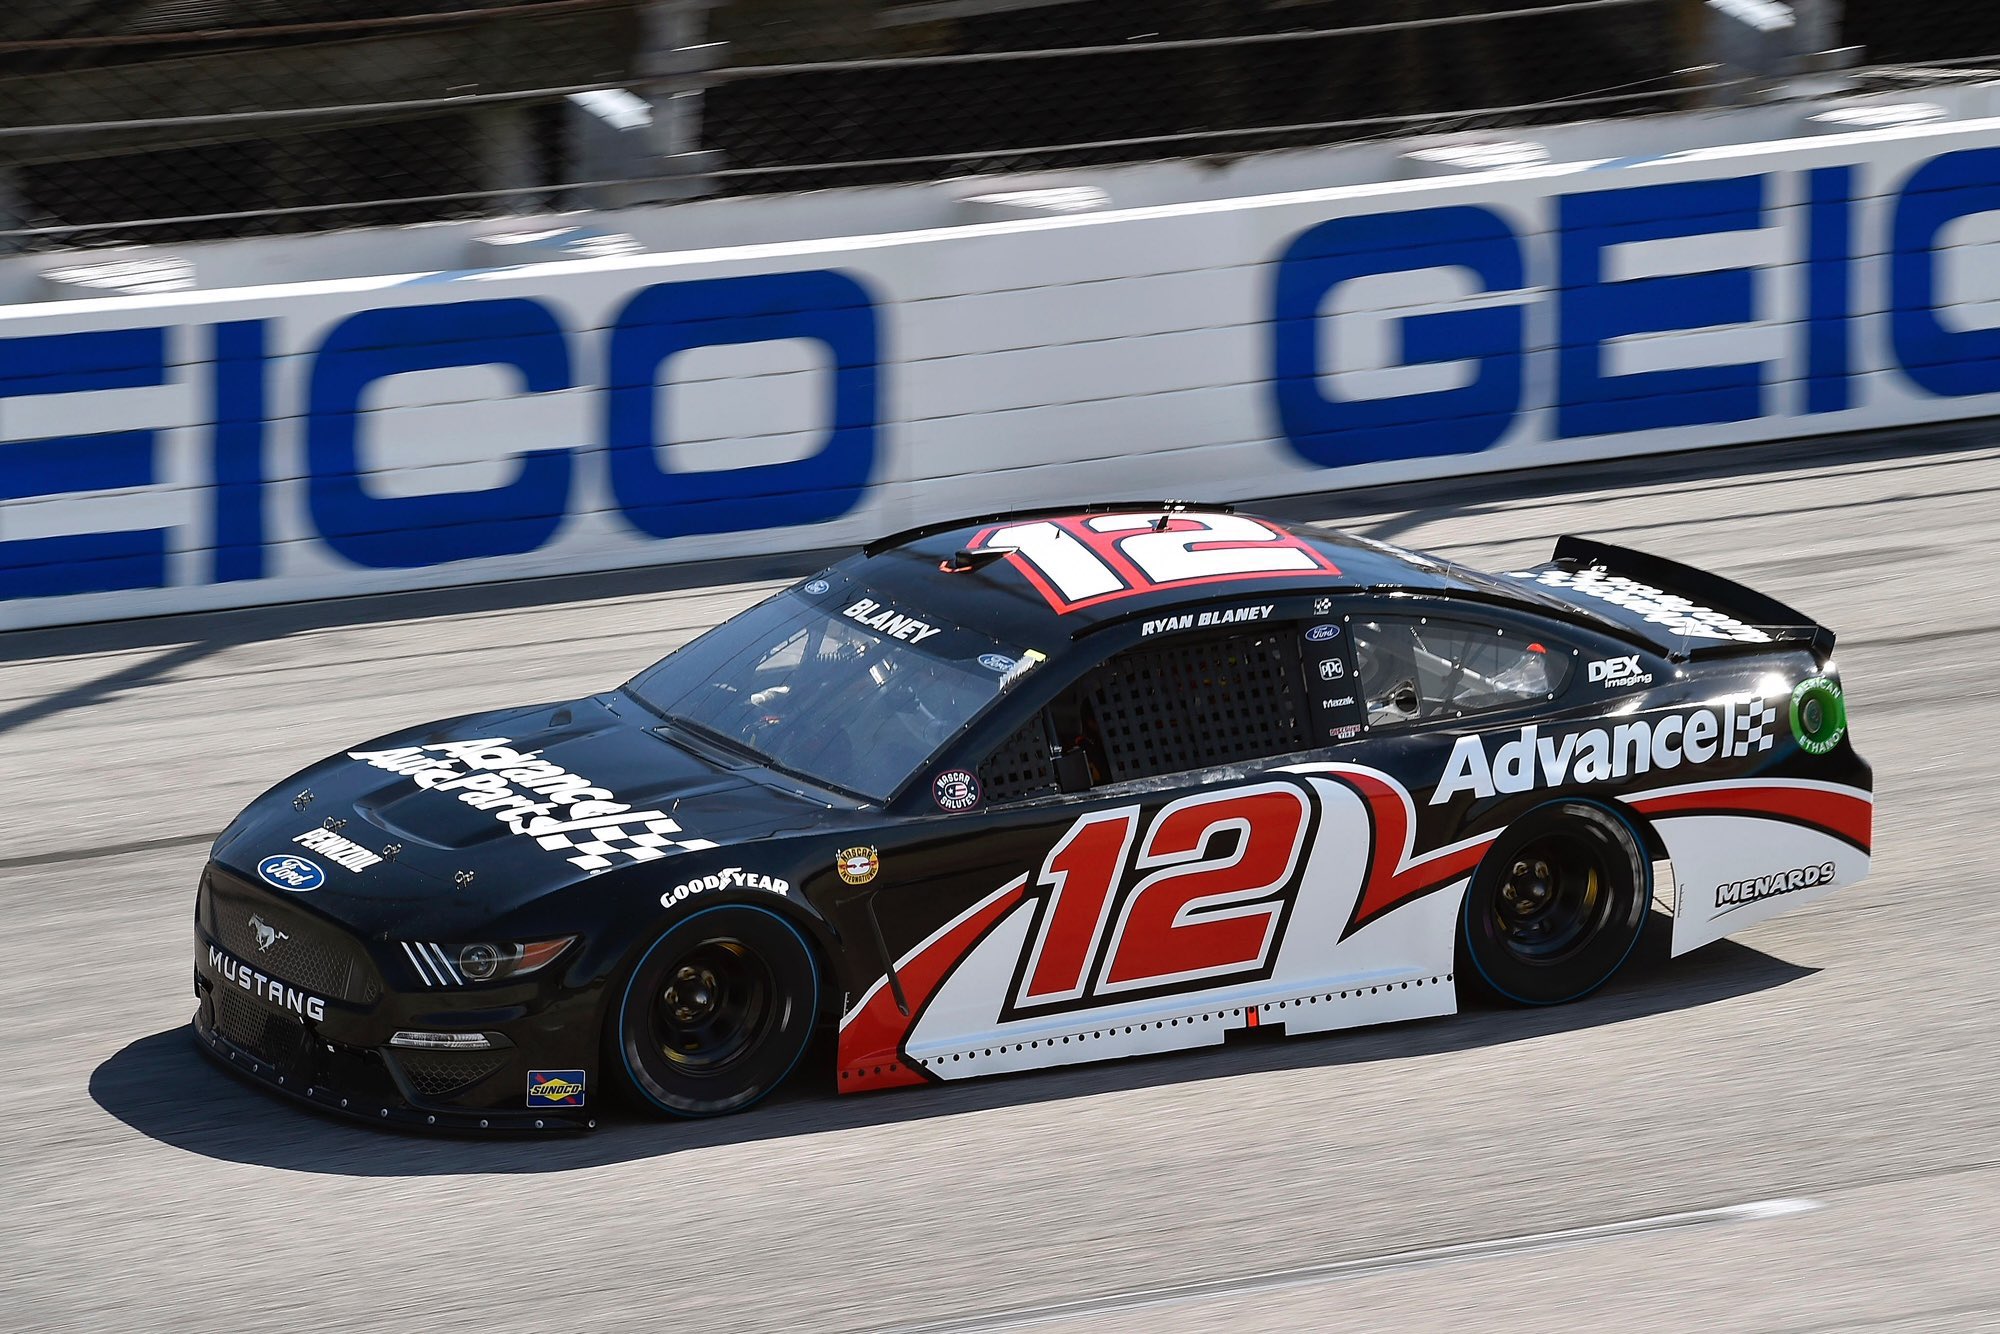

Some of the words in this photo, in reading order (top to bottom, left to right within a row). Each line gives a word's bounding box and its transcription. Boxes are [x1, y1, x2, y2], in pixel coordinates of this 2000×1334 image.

[985, 512, 1320, 603] 12
[843, 598, 941, 644] BLANEY
[1141, 613, 1194, 637] RYAN
[1197, 604, 1275, 627] BLANEY
[1321, 661, 1342, 678] PPG
[1588, 654, 1644, 683] DEX
[1429, 706, 1719, 806] Advance
[1799, 727, 1845, 753] ETHANOL
[422, 737, 632, 820] Advance
[936, 772, 970, 790] NASCAR
[940, 792, 977, 809] SALUTES
[292, 827, 384, 873] PENNZOIL
[841, 848, 873, 862] NASCAR
[266, 858, 315, 886] Ford
[660, 867, 790, 909] GOODYEAR
[1715, 861, 1836, 908] MENARDS
[1013, 781, 1312, 1009] 12
[209, 945, 326, 1022] MUSTANG
[531, 1084, 581, 1095] SUNOCO
